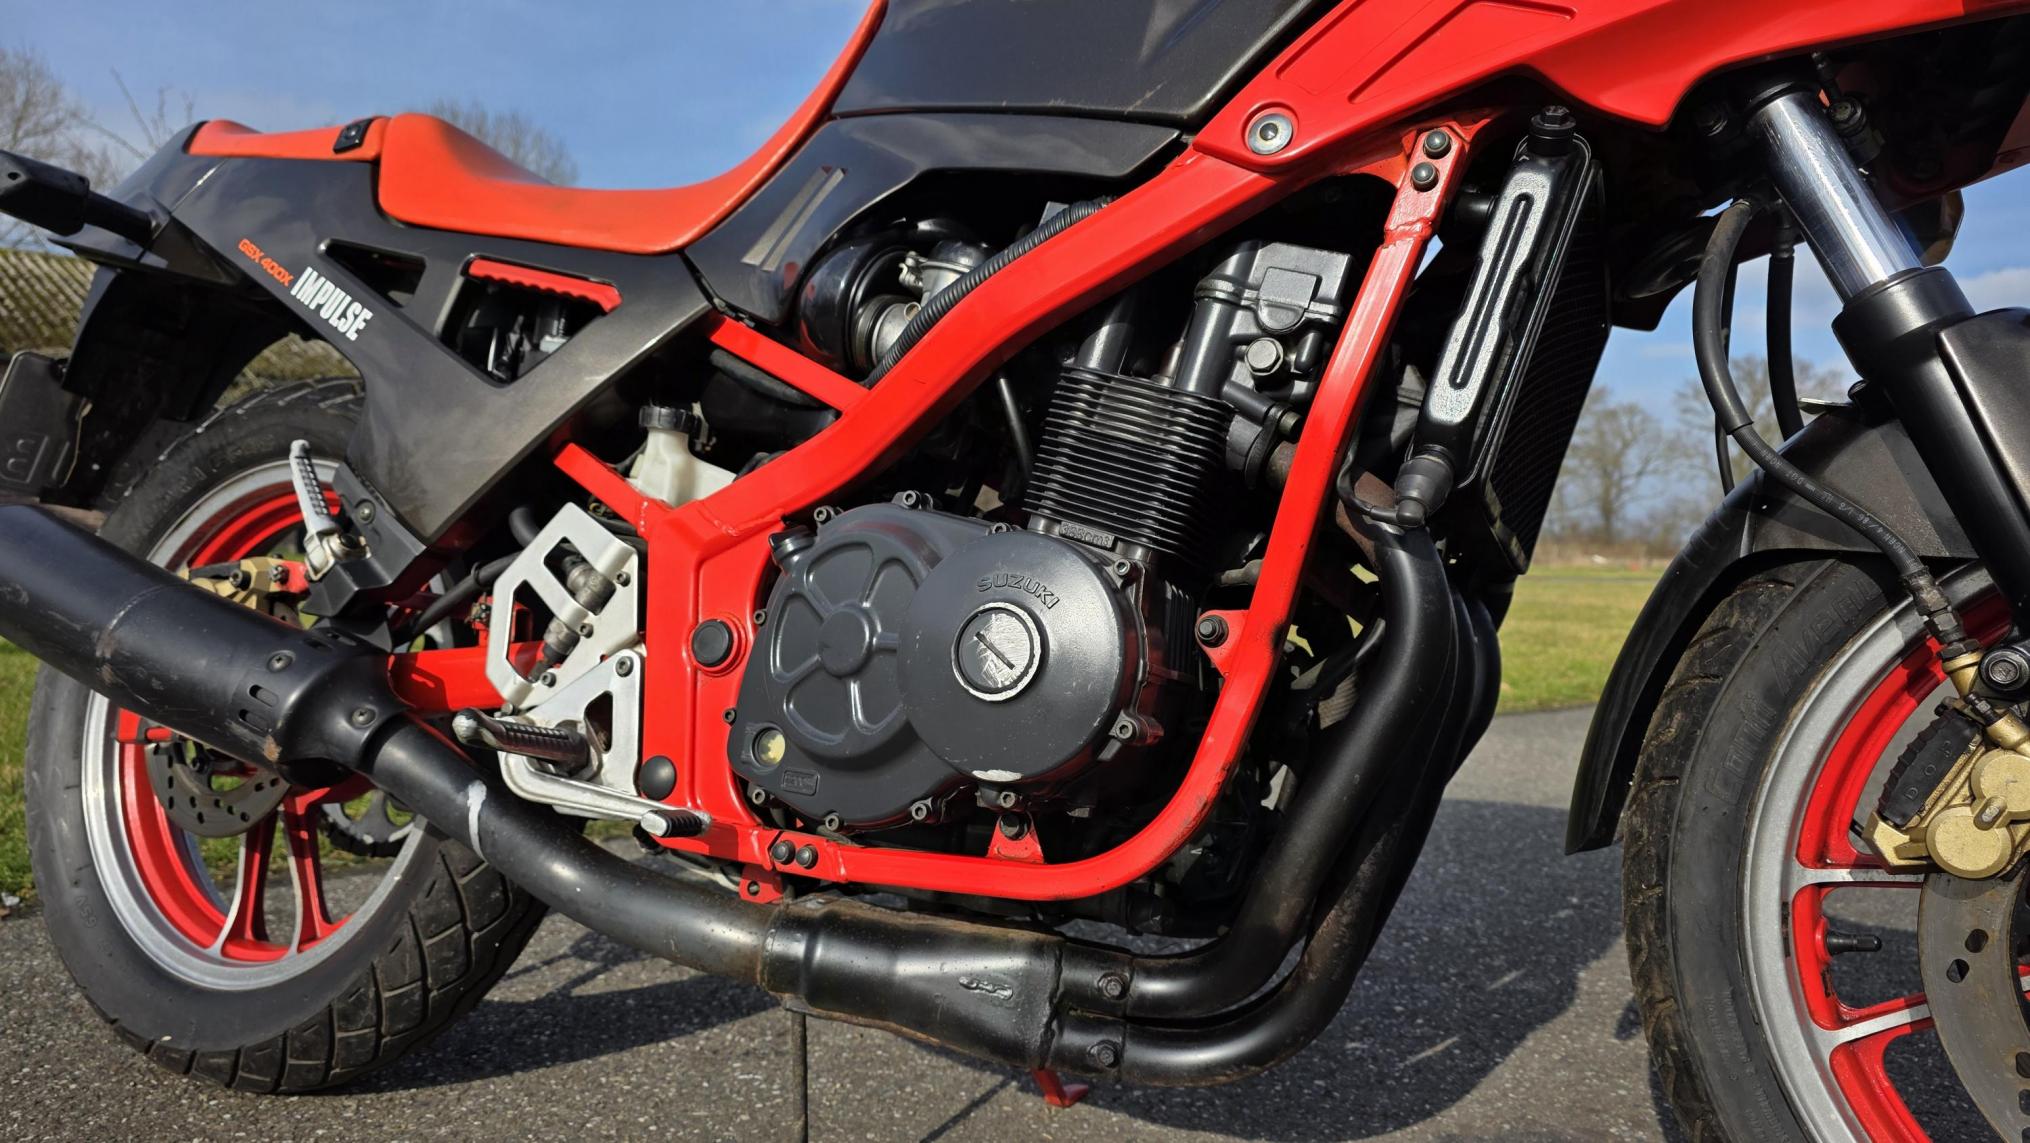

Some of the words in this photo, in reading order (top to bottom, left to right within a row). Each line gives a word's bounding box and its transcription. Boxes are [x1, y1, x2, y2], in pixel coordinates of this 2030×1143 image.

[238, 238, 264, 264] GSX
[260, 257, 295, 287] 400X
[290, 266, 373, 341] IMPULSE
[976, 573, 1060, 609] SUZUKI
